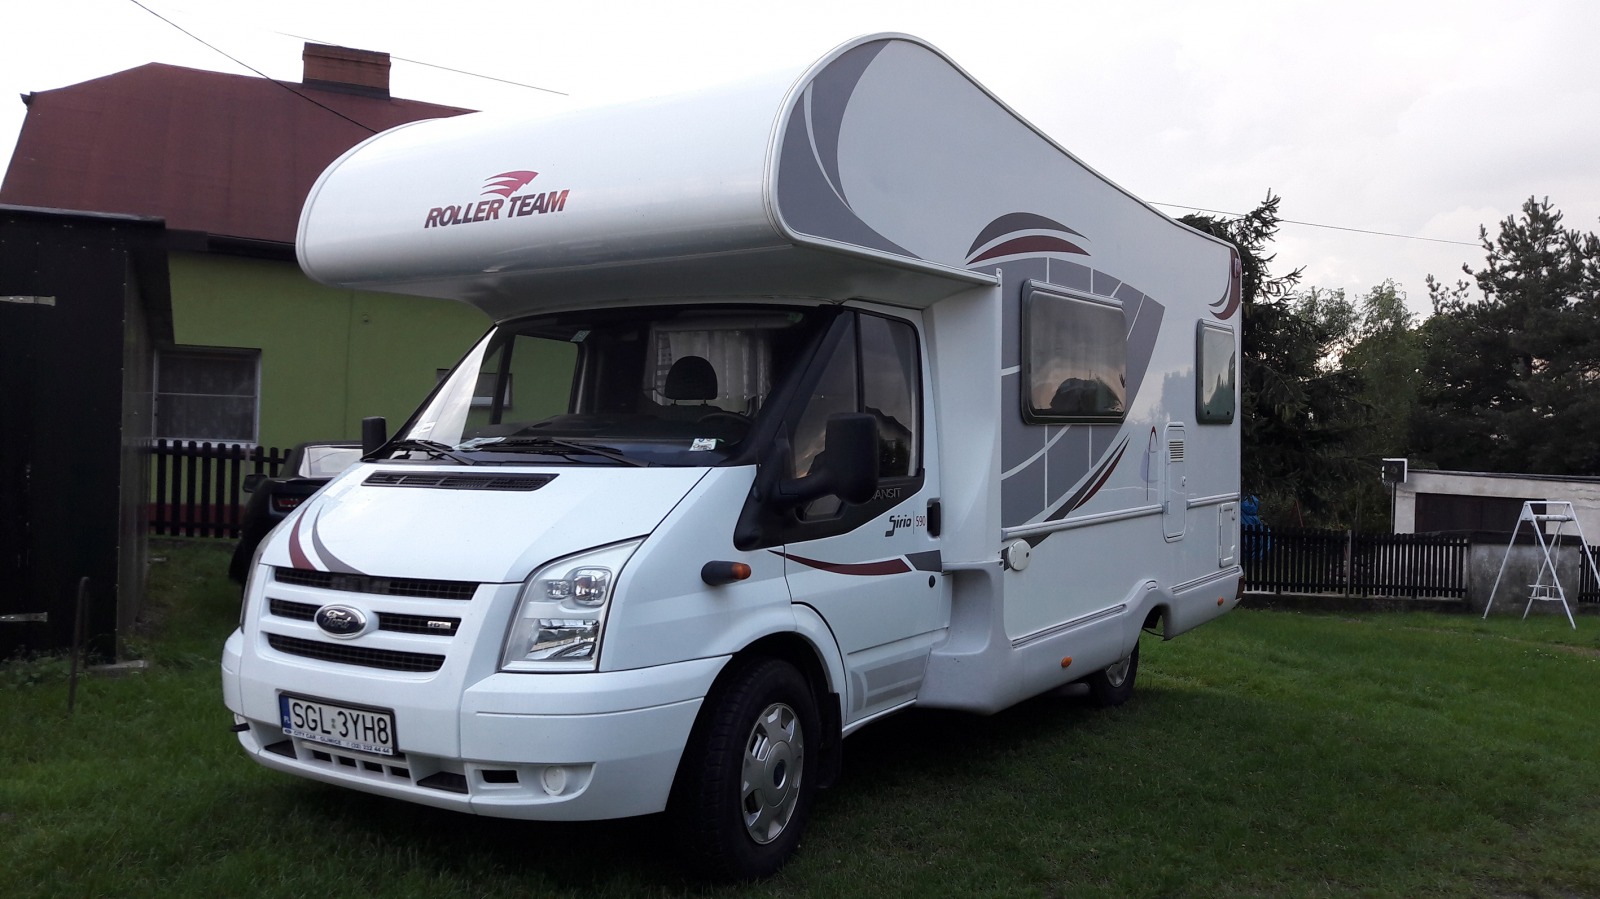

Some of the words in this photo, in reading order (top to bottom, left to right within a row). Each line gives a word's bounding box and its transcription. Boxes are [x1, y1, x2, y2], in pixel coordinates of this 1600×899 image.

[424, 199, 504, 228] ROLLER
[507, 189, 570, 218] TEAM
[873, 488, 901, 499] ANSIT
[885, 514, 912, 537] Sirio
[916, 515, 926, 527] 590
[292, 702, 332, 735] SGL
[337, 710, 389, 744] 3YH8
